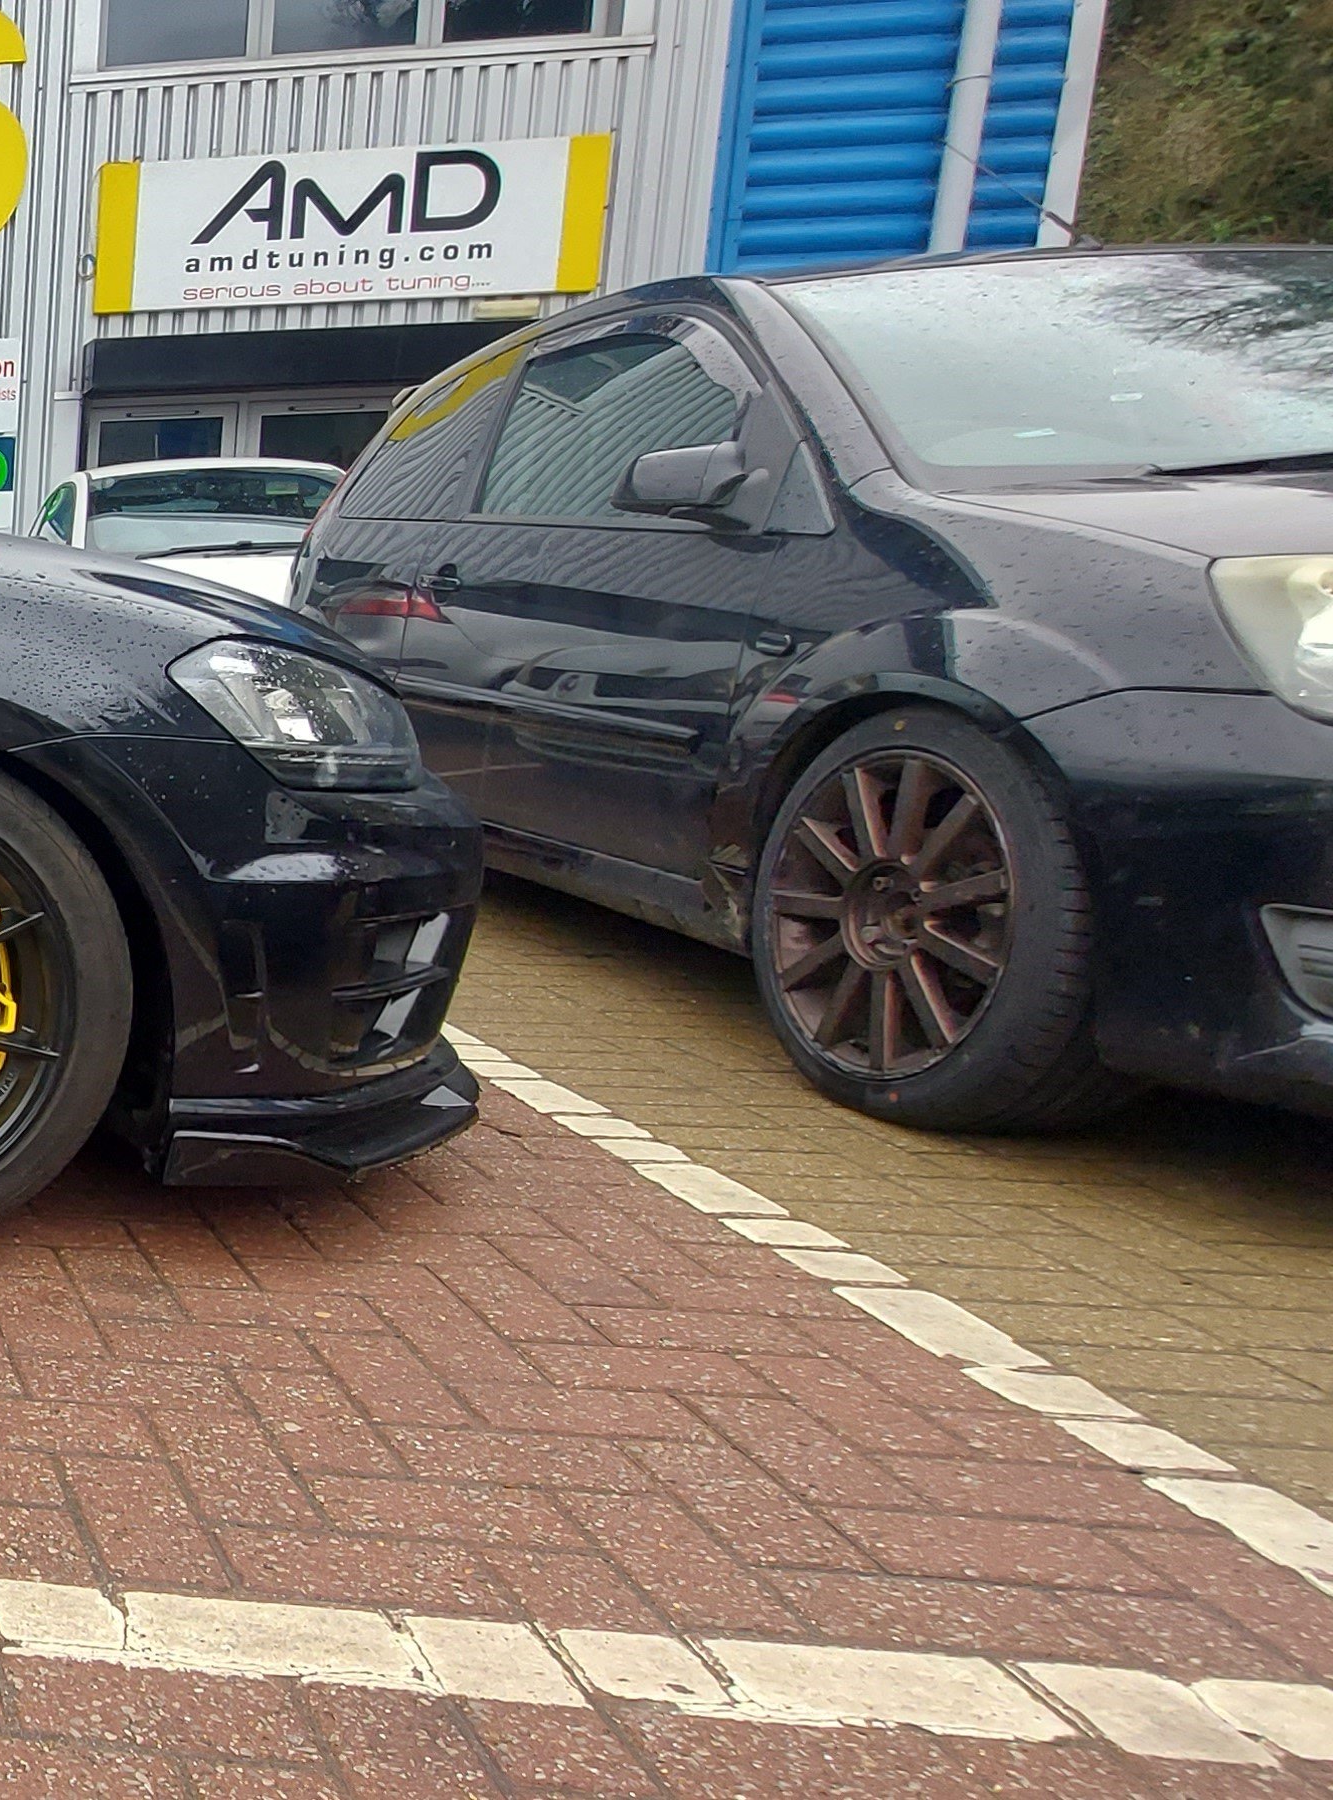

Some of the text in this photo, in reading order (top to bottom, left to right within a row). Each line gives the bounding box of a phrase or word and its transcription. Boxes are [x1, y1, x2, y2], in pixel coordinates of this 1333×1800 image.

[185, 243, 492, 272] amdtuning.com
[183, 284, 281, 300] serious
[293, 278, 373, 295] about
